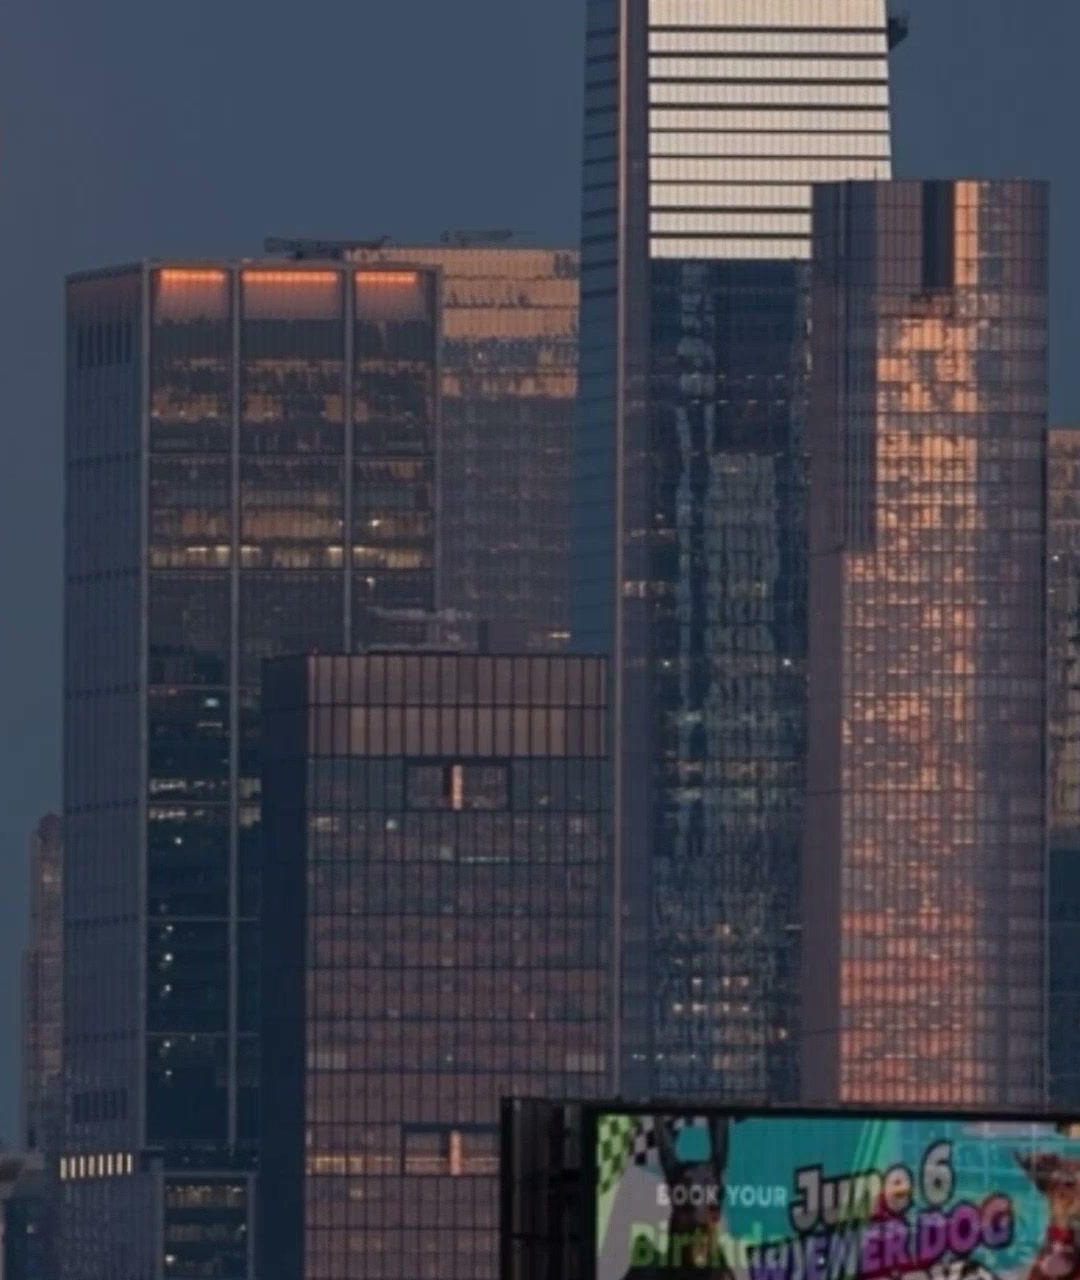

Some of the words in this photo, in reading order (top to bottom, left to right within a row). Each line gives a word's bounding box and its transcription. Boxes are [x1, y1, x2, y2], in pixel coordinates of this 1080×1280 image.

[656, 1184, 719, 1206] BOOK
[726, 1184, 788, 1207] YOUR
[791, 1165, 913, 1231] June
[920, 1139, 954, 1206] 6
[917, 1194, 1014, 1262] DOG
